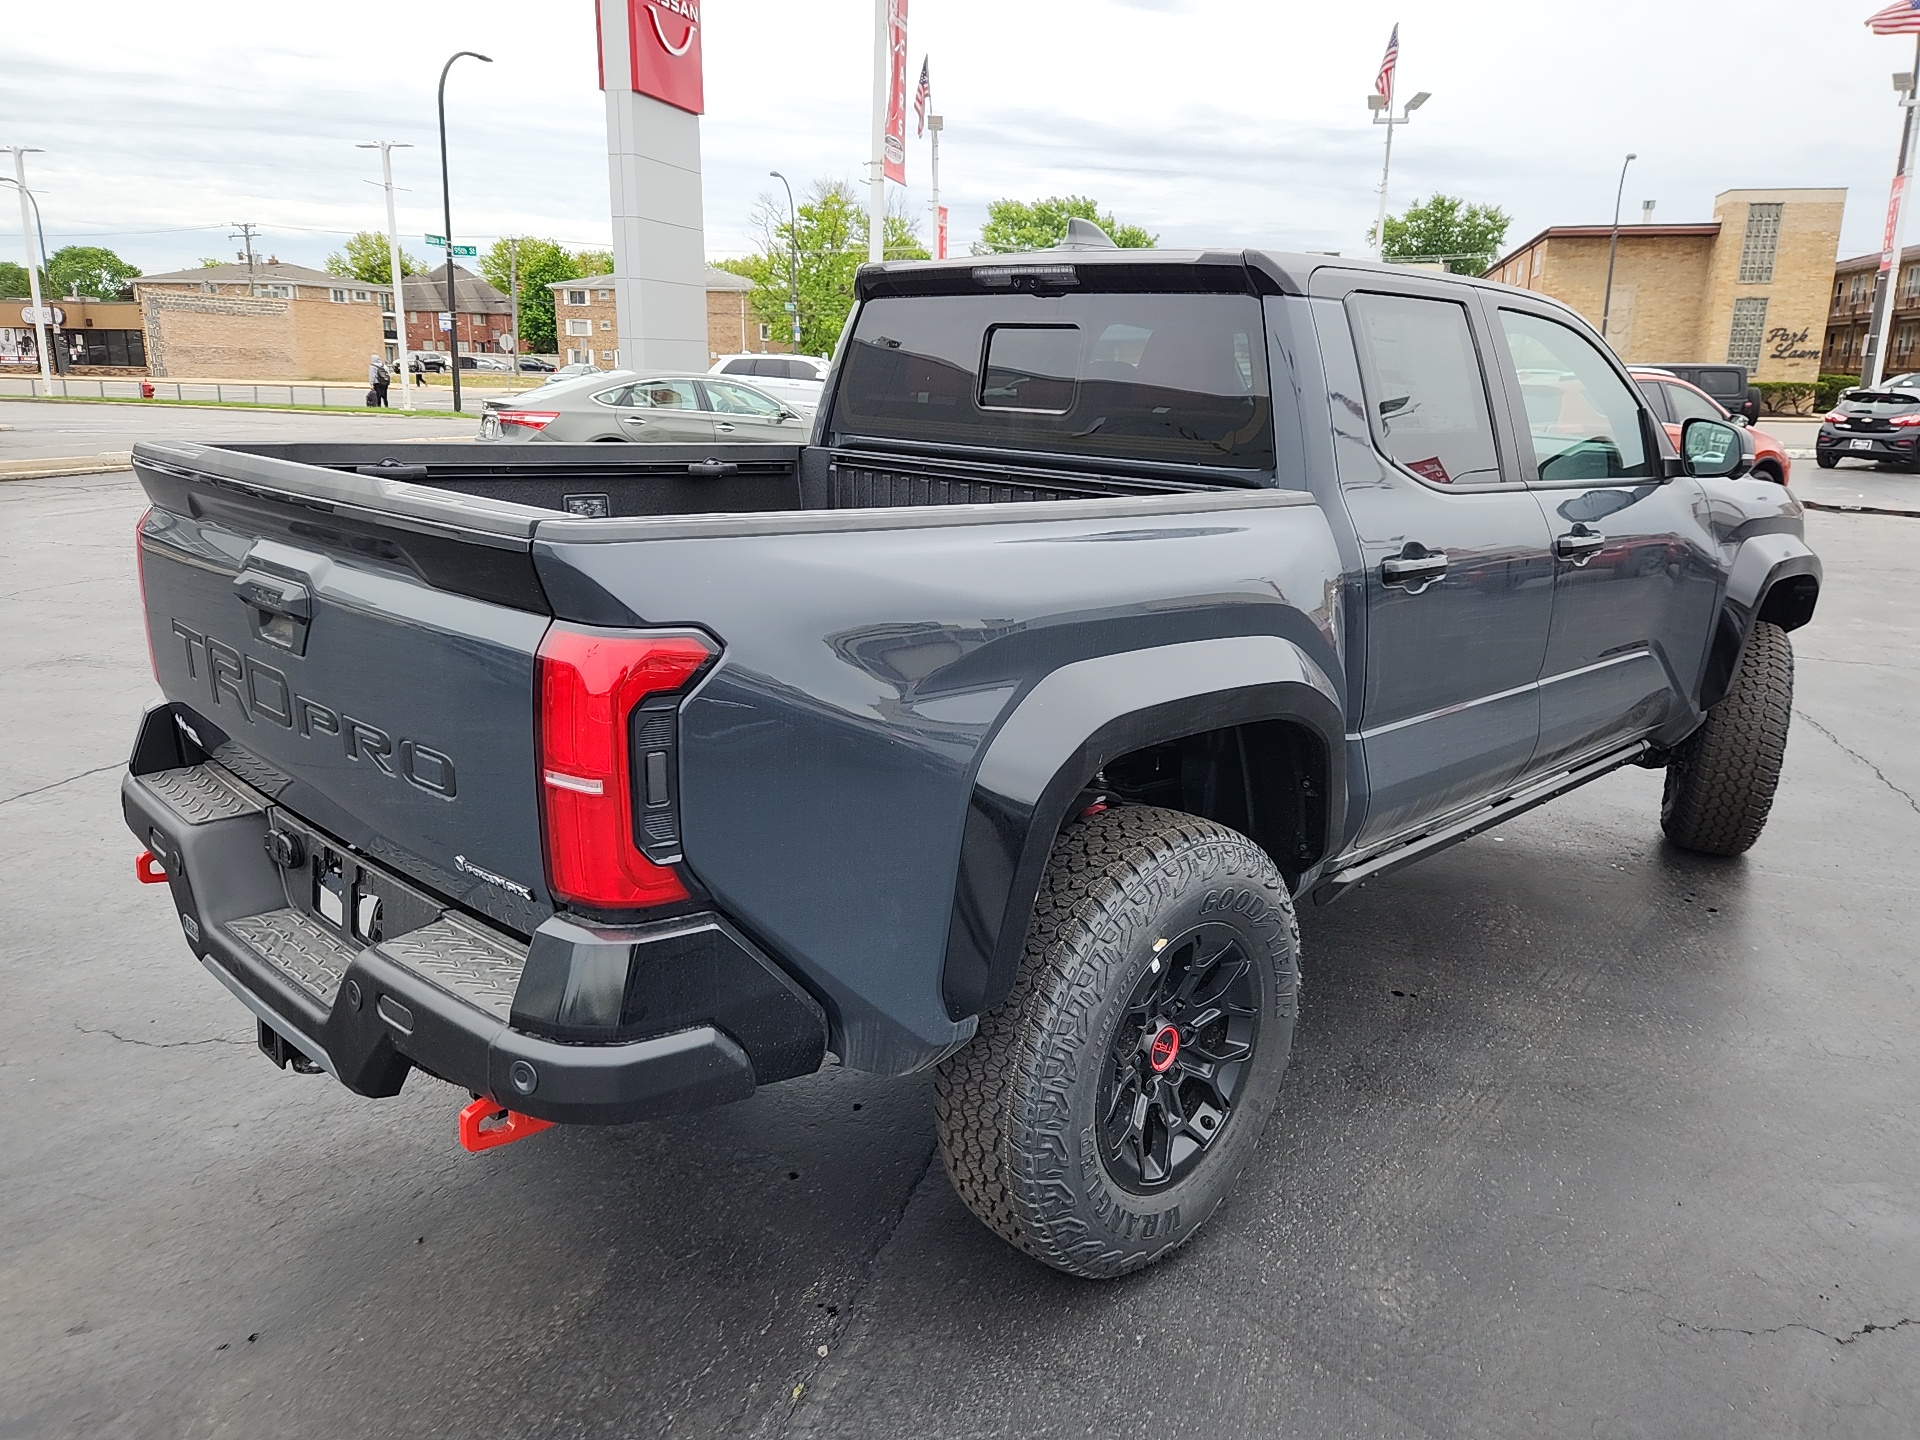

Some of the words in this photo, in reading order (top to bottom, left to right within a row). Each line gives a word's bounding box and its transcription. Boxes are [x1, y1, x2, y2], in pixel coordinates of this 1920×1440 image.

[648, 0, 699, 23] SSAN
[453, 246, 468, 255] 95th
[468, 247, 476, 255] St
[1766, 327, 1809, 343] Park
[1770, 342, 1820, 360] Lawn
[171, 616, 293, 730] TRD
[295, 692, 458, 802] PRO
[1200, 886, 1293, 1018] GOODYEAR
[1080, 1123, 1181, 1240] WRANGLER
